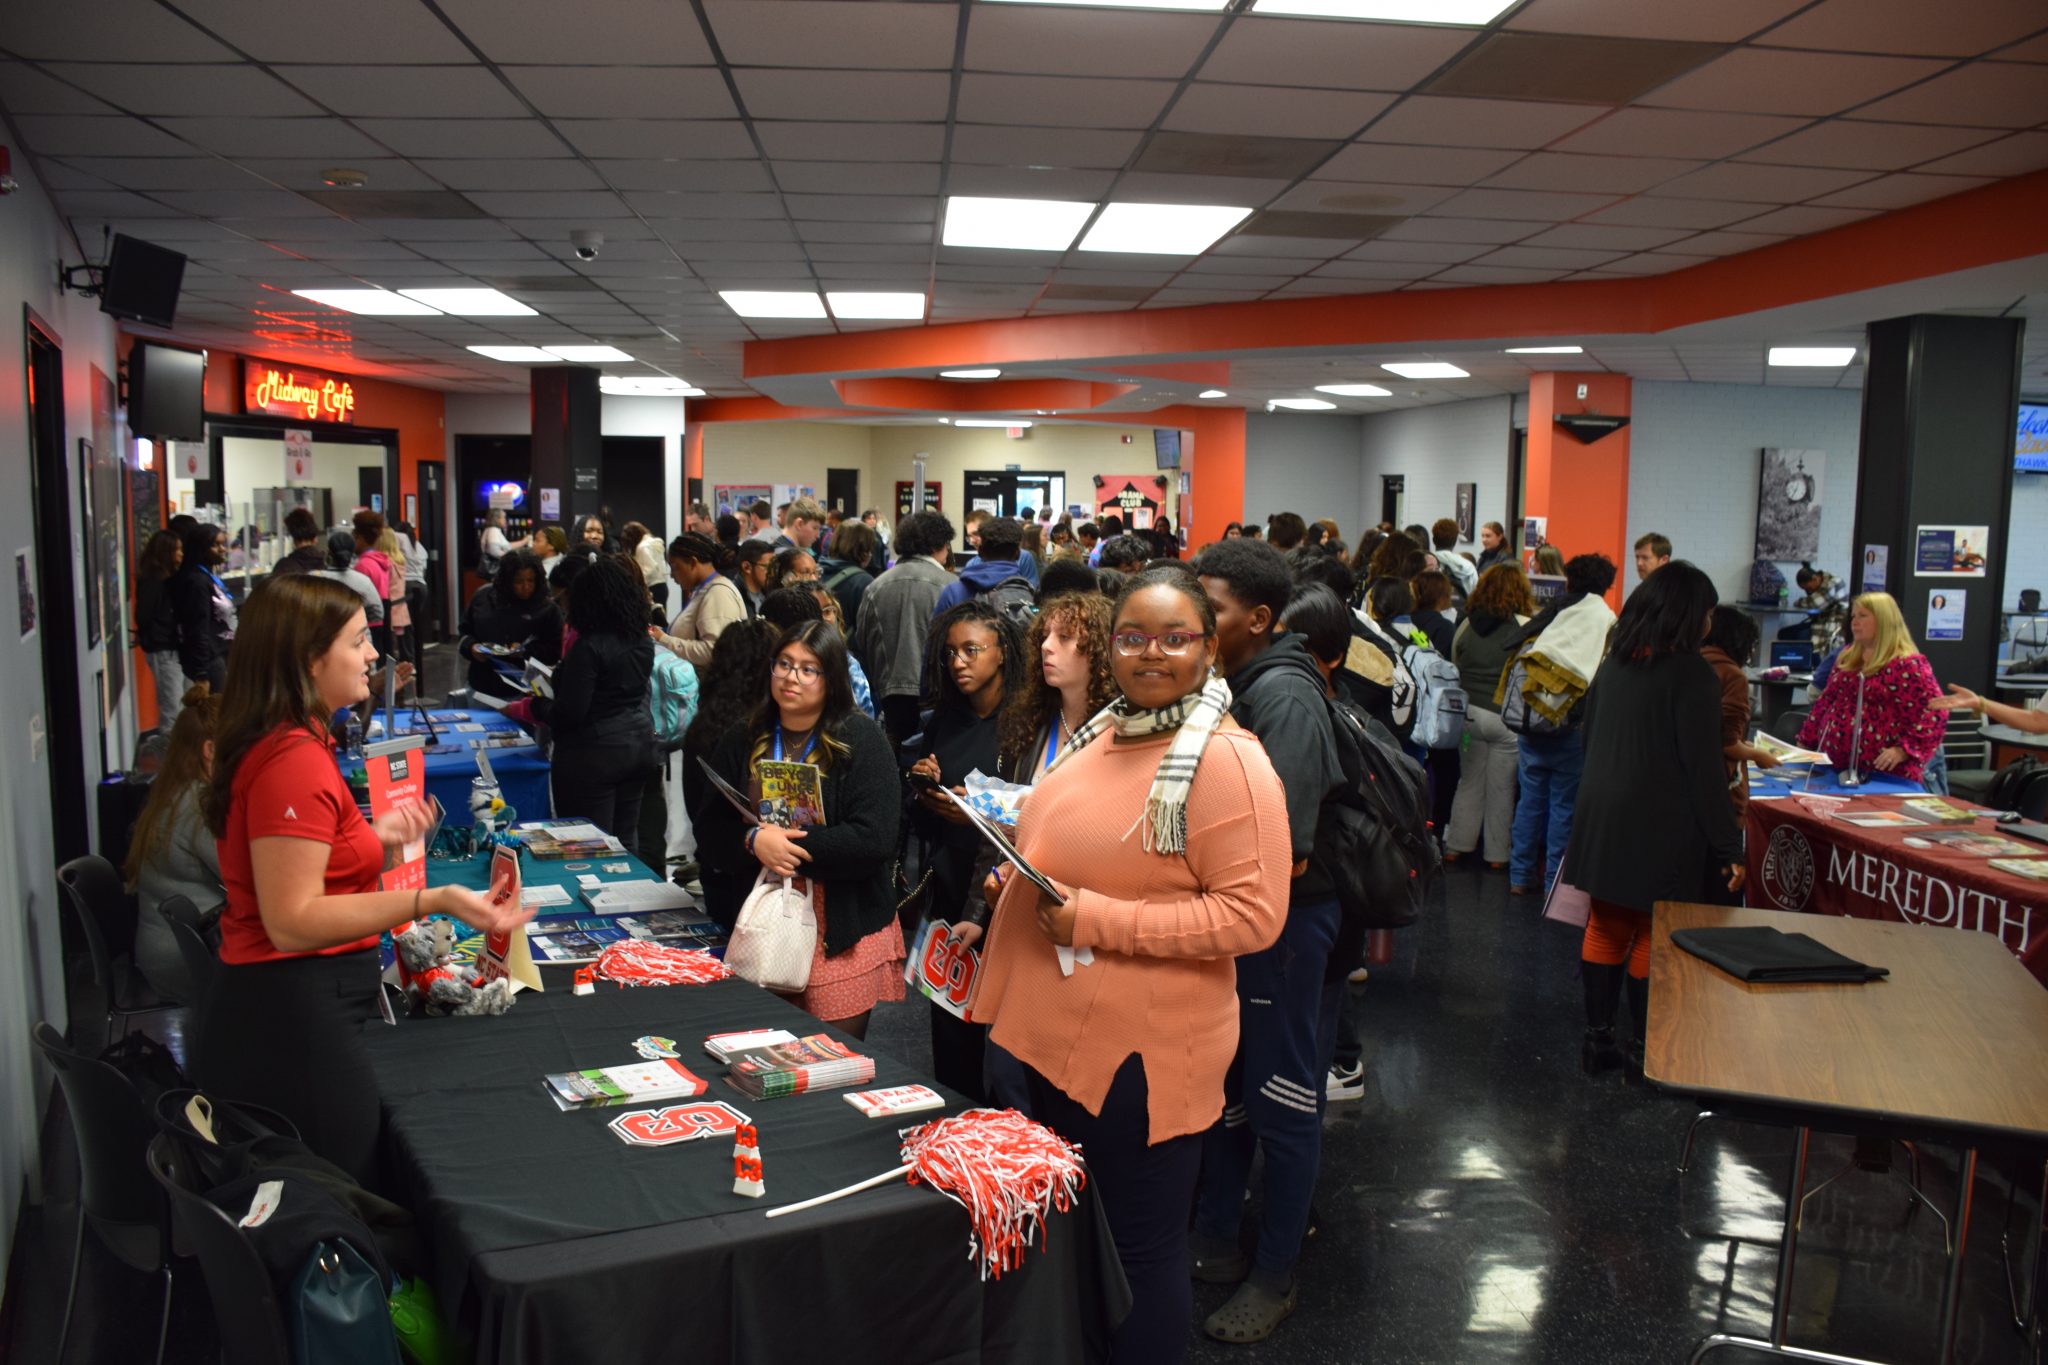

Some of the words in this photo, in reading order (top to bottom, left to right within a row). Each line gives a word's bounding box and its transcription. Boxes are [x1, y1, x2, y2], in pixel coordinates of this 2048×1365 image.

[256, 370, 319, 419] Midway
[322, 379, 354, 422] Café
[1120, 499, 1142, 508] CLUB
[764, 767, 785, 779] BE
[1827, 842, 2032, 953] MEREDITH
